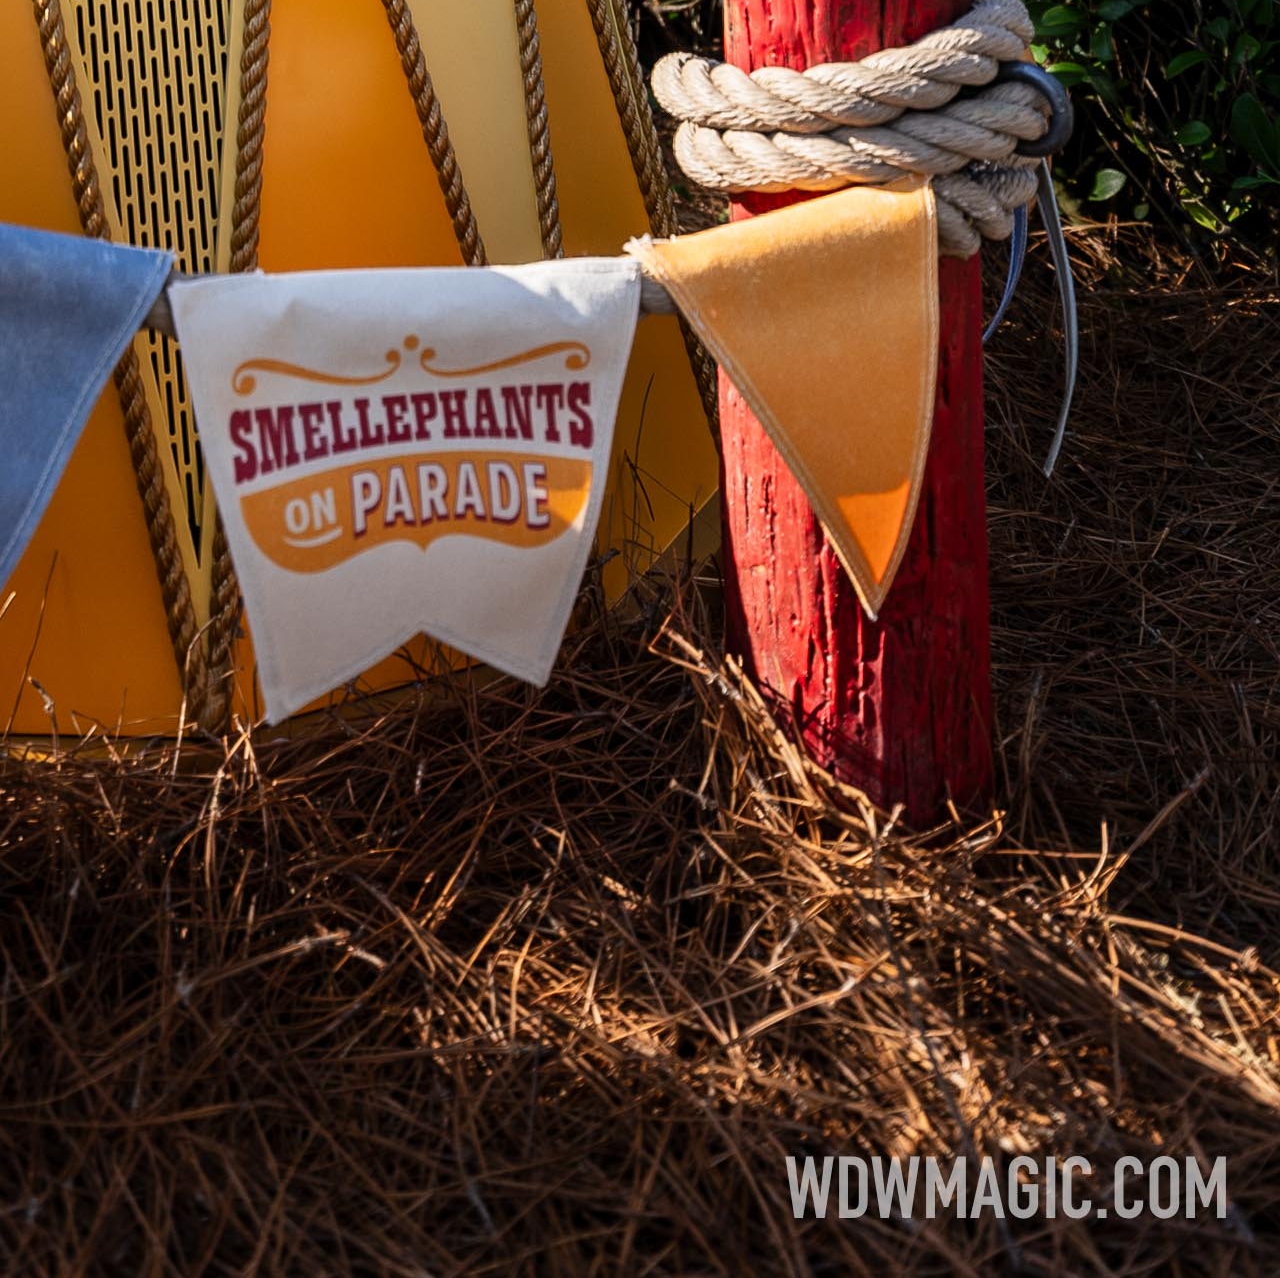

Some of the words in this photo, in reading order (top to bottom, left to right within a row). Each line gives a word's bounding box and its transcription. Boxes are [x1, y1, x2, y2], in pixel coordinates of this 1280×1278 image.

[229, 381, 595, 485] SMELLEPHANTS
[283, 487, 338, 534] ON
[350, 461, 552, 539] PARADE
